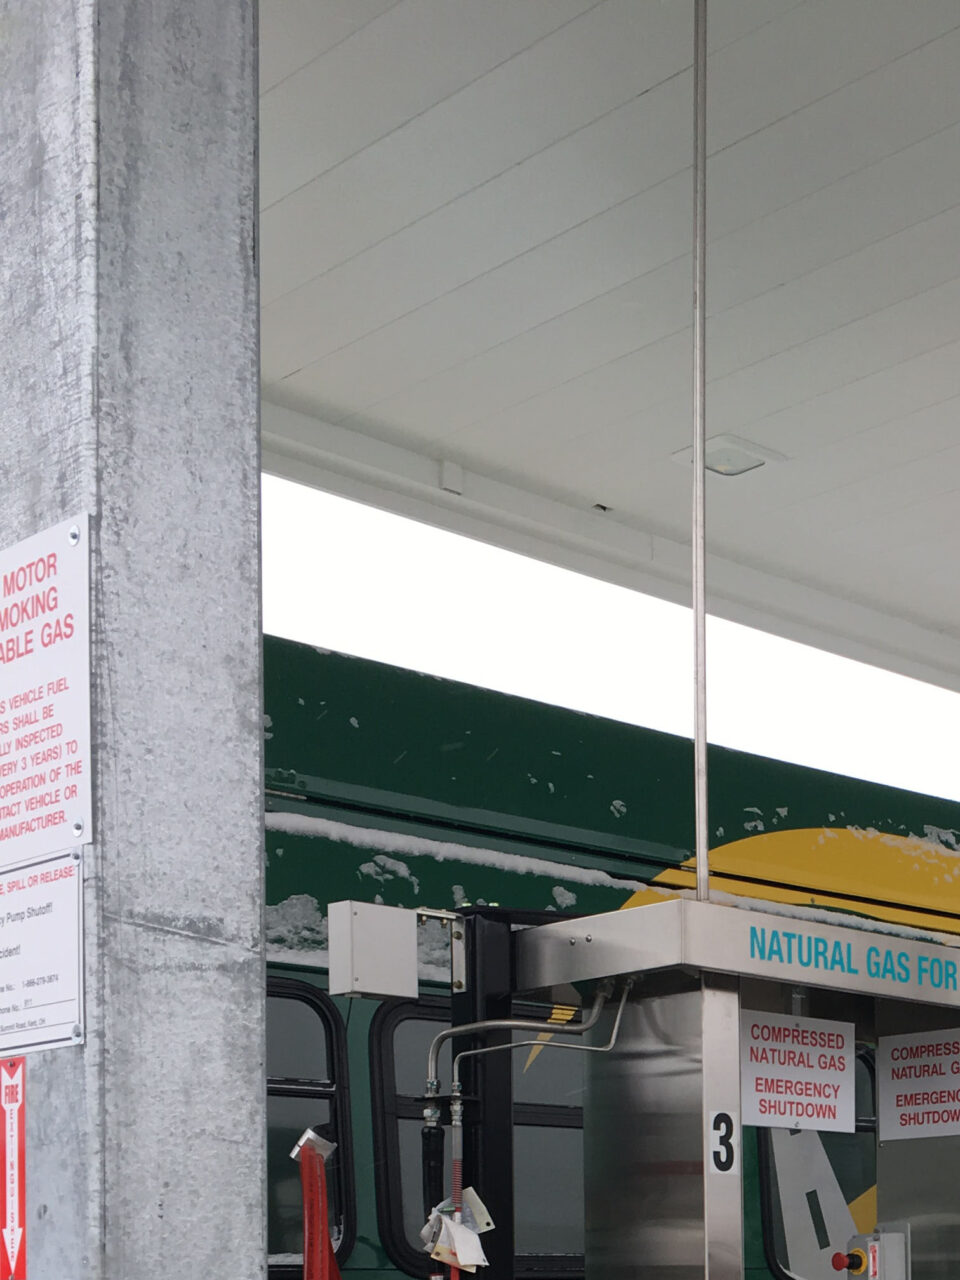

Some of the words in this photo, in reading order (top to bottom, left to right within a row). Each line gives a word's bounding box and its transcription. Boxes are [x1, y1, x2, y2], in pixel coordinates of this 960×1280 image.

[3, 552, 57, 597] MOTOR
[41, 612, 74, 648] GAS
[8, 686, 44, 710] VEHICLE
[47, 677, 69, 696] FUEL
[12, 709, 39, 731] SHALL
[42, 704, 54, 721] BE
[15, 723, 63, 751] INSPECTED
[21, 757, 28, 771] 3
[30, 744, 62, 768] YEARS)
[65, 740, 78, 757] TO
[0, 772, 46, 799] OPERATION
[49, 767, 62, 784] OF
[65, 760, 83, 778] THE
[24, 789, 61, 812] VEHICLE
[64, 784, 78, 801] OR
[7, 878, 26, 893] SPILL
[28, 874, 38, 888] OR
[6, 910, 25, 923] Pump
[750, 926, 859, 975] NATURAL
[866, 946, 910, 983] GAS
[917, 955, 957, 991] FOR
[751, 1024, 845, 1050] COMPRESSED
[750, 1046, 814, 1069] NATURAL
[818, 1054, 846, 1072] GAS
[891, 1063, 946, 1080] NATURAL
[755, 1077, 840, 1099] EMERGENCY
[759, 1099, 836, 1120] SHUTDOWN
[713, 1112, 734, 1171] 3
